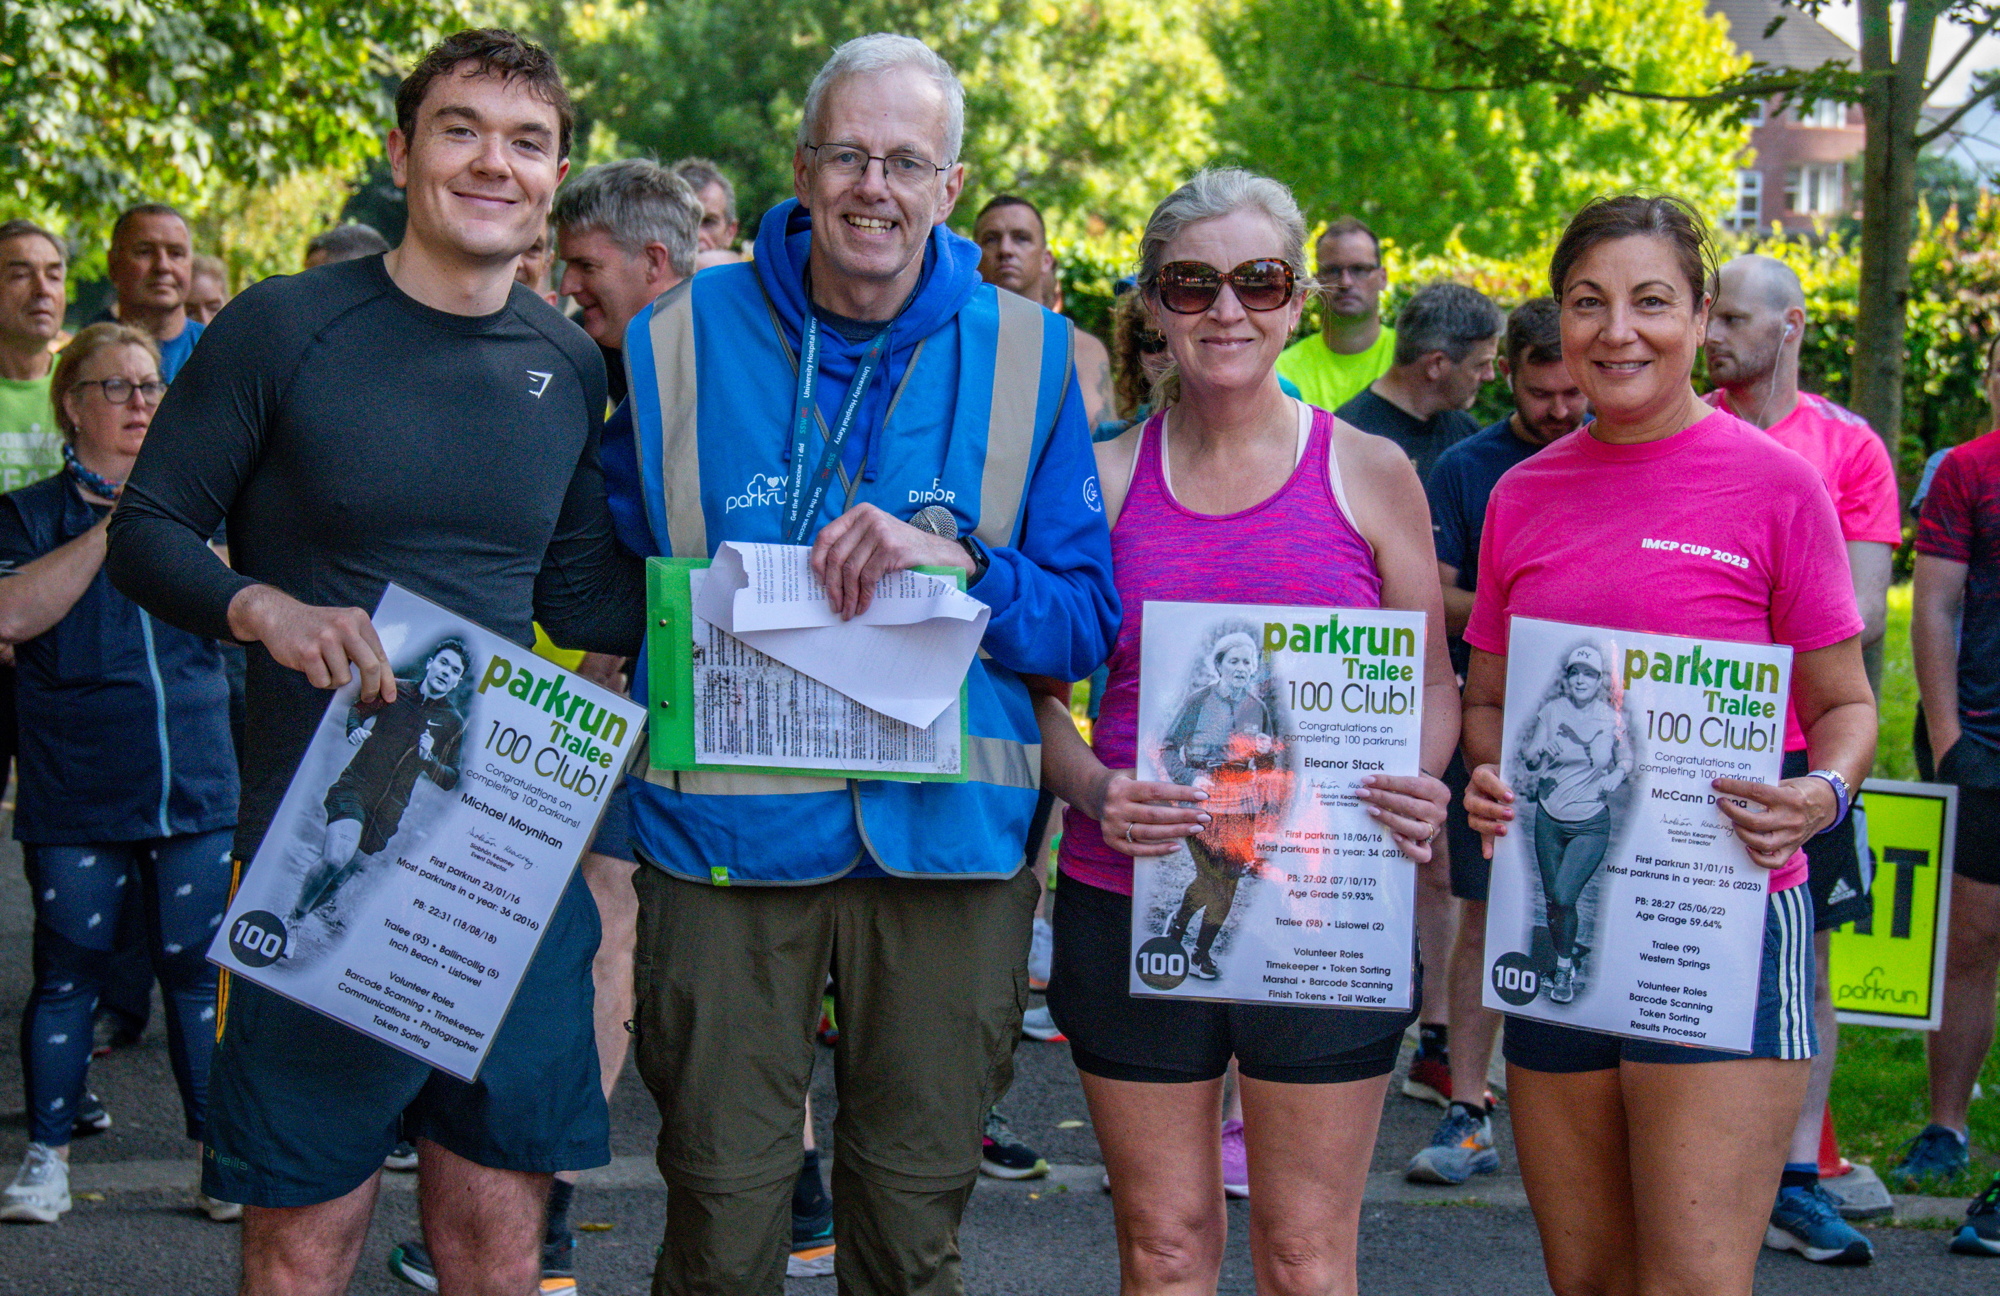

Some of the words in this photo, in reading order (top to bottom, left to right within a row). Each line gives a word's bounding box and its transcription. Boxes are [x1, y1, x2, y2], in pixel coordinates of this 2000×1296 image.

[810, 316, 818, 334] Kerry
[807, 334, 816, 363] Hospital
[803, 364, 815, 398] University
[853, 366, 871, 399] University
[842, 399, 858, 427] Hospital
[834, 427, 846, 445] Kerry
[790, 510, 798, 521] Get
[795, 464, 803, 488] vaccine
[1641, 538, 1680, 551] IMCP
[1680, 543, 1712, 556] CUP
[1711, 549, 1750, 569] 2023
[1263, 614, 1416, 662] parkrun
[1342, 658, 1413, 681] Tralee
[1623, 645, 1780, 694] parkrun
[477, 655, 628, 748] parkrun
[1289, 681, 1332, 712] 100
[1341, 683, 1414, 715] Club!
[1703, 690, 1775, 718] Tralee
[1283, 732, 1340, 746] completing
[1345, 735, 1360, 745] 100
[1363, 737, 1406, 747] parkruns!
[1299, 721, 1377, 734] Congratulations
[1380, 726, 1393, 734] on
[1647, 710, 1691, 744] 100
[1700, 717, 1776, 753] Club!
[550, 720, 612, 768] Tralee
[486, 720, 532, 764] 100
[535, 747, 608, 802] Club!
[1305, 758, 1348, 770] Eleanor
[1352, 760, 1384, 771] Stack
[1638, 760, 1696, 779] completing
[1701, 769, 1717, 781] 100
[1655, 752, 1735, 769] Congratulations
[1738, 763, 1751, 771] on
[464, 766, 519, 800] completing
[522, 794, 538, 808] 100
[538, 804, 580, 828] parkruns!
[486, 763, 557, 804] Congratulations
[559, 801, 572, 811] on
[1652, 788, 1702, 803] McCann
[1708, 795, 1747, 809] Dna
[461, 793, 507, 822] Michael
[508, 816, 562, 849] Moynihan
[1285, 830, 1302, 839] First
[1305, 832, 1339, 841] parkrun
[1344, 833, 1382, 843] 18/06/16
[1256, 844, 1278, 853] Most
[1280, 846, 1319, 855] parkruns
[1323, 846, 1330, 855] in
[1368, 849, 1378, 857] 34
[1382, 850, 1409, 860] (2017
[1636, 855, 1652, 865] First
[1655, 859, 1690, 870] parkrun
[1693, 862, 1734, 875] 31/01/15
[430, 856, 447, 869] First
[447, 866, 480, 886] parkrun
[482, 881, 520, 904] 23/01/16
[1288, 874, 1300, 883] PB:
[1304, 875, 1327, 885] 27:02
[1330, 876, 1376, 887] (07/10/17)
[1607, 865, 1628, 876] Most
[1630, 870, 1669, 881] parkruns
[1672, 874, 1680, 883] in
[1692, 878, 1715, 887] year:
[1719, 879, 1730, 889] 26
[1733, 882, 1761, 893] (2023)
[396, 856, 418, 872] Most
[418, 870, 456, 891] parkruns
[458, 886, 466, 896] in
[476, 896, 498, 911] year:
[500, 907, 511, 916] 36
[513, 913, 539, 930] (2016)
[1288, 890, 1307, 900] Age
[1310, 890, 1339, 900] Grade
[1342, 892, 1374, 901] 59.93%
[1636, 896, 1648, 906] PB:
[1652, 899, 1675, 909] 28:27
[1678, 903, 1725, 917] (25/06/22)
[413, 899, 426, 910] PB:
[428, 906, 451, 922] 22:31
[453, 918, 497, 944] (18/08/18)
[1276, 917, 1302, 927] Tralee
[1306, 919, 1323, 929] (98)
[1335, 921, 1369, 931] Listowel
[1372, 922, 1384, 932] (2)
[1636, 911, 1654, 922] Age
[1658, 914, 1687, 926] Grage
[1690, 918, 1722, 930] 59.64%
[234, 920, 282, 958] 100
[384, 918, 410, 936] Tralee
[412, 933, 429, 946] (93)
[439, 945, 485, 973] Ballincollig
[487, 968, 499, 979] (5)
[1652, 940, 1679, 952] Tralee
[1683, 945, 1700, 955] (99)
[389, 938, 410, 953] Inch
[410, 948, 438, 967] Beach
[448, 966, 482, 987] Listowel
[1137, 952, 1184, 976] 100
[1294, 948, 1337, 958] Volunteer
[1340, 950, 1364, 960] Roles
[1640, 953, 1674, 965] Western
[1678, 958, 1710, 971] Springs
[1266, 960, 1319, 973] Timekeeper
[1330, 964, 1357, 975] Token
[1360, 966, 1391, 978] Sorting
[1493, 966, 1536, 993] 100
[390, 972, 430, 996] Volunteer
[432, 992, 454, 1008] Roles
[1263, 975, 1298, 985] Marshal
[1310, 978, 1348, 988] Barcode
[1351, 980, 1393, 992] Scanning
[1268, 990, 1292, 999] Finish
[1296, 992, 1326, 1001] Tokens
[1338, 994, 1352, 1003] Tail
[1355, 995, 1386, 1004] Walker
[1637, 980, 1680, 994] Volunteer
[1683, 986, 1707, 998] Roles
[1838, 974, 1918, 1004] parkrun
[345, 968, 382, 991] Barcode
[384, 987, 424, 1012] Scanning
[434, 1010, 485, 1039] Timekeeper
[1629, 993, 1667, 1006] Barcode
[1670, 999, 1712, 1014] Scanning
[1640, 1008, 1665, 1020] Token
[1669, 1012, 1700, 1026] Sorting
[338, 982, 410, 1021] Communications
[420, 1020, 478, 1053] Photographer
[1630, 1020, 1660, 1033] Results
[1663, 1025, 1706, 1039] Processor
[373, 1015, 398, 1032] Token
[400, 1028, 430, 1049] Sorting
